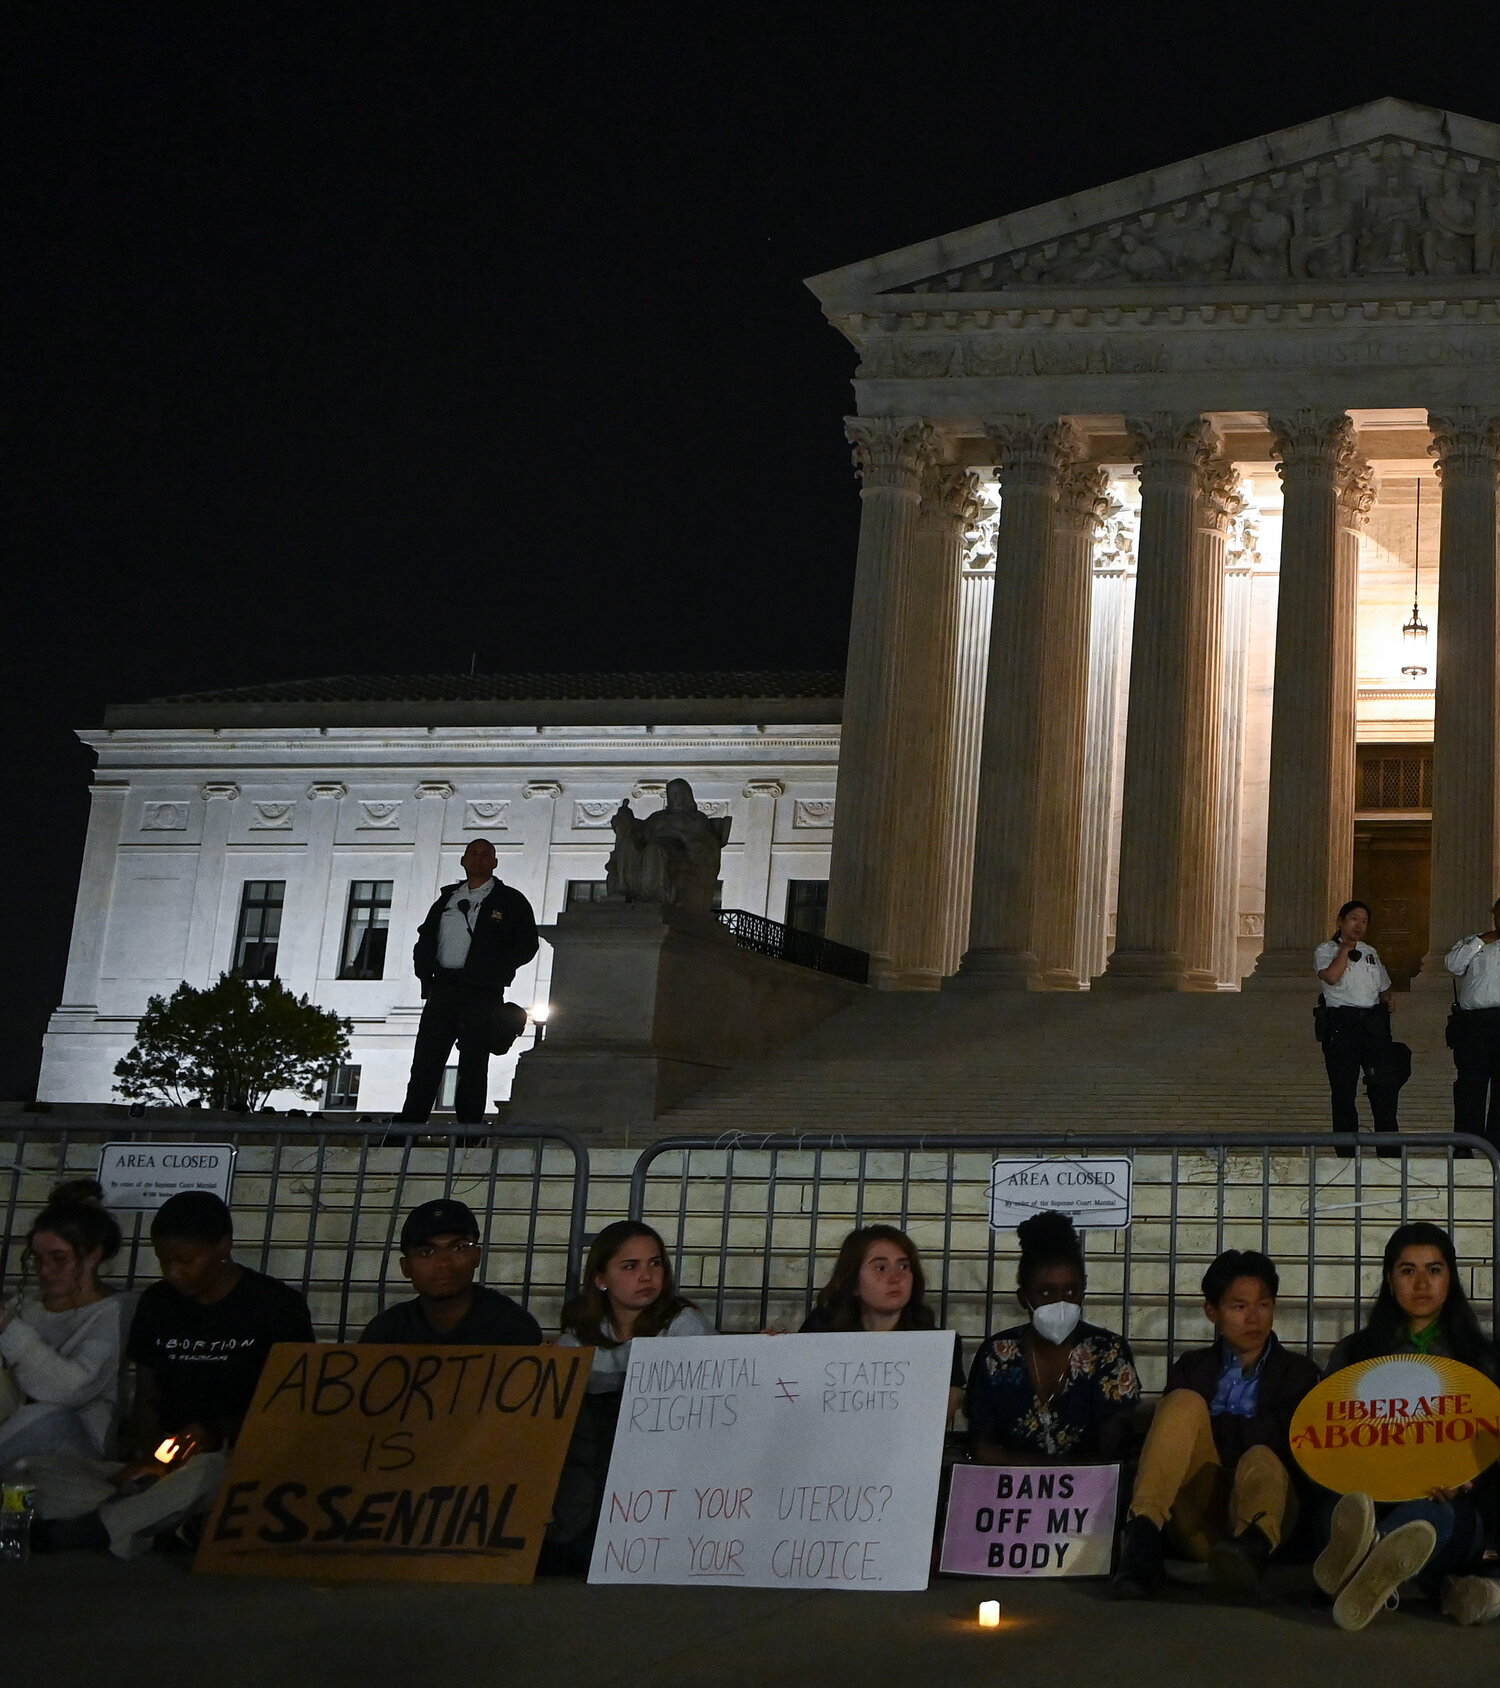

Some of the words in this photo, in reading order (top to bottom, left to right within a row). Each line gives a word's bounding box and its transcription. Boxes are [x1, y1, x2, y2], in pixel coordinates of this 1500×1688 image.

[116, 1154, 155, 1168] AREA
[162, 1155, 219, 1169] CLOSED
[1008, 1172, 1050, 1186] AREA
[1057, 1171, 1115, 1186] CLOSED
[263, 1350, 581, 1421] ABORTION
[628, 1358, 760, 1394] FUNDAMENTAL
[629, 1394, 738, 1432] RIGHTS
[823, 1389, 899, 1413] RIGHTS
[1326, 1394, 1472, 1421] LIBERATE
[1291, 1416, 1500, 1449] ABORTION
[363, 1432, 416, 1472] IS
[997, 1473, 1074, 1499] BANS
[214, 1480, 526, 1550] ESSENTIAL
[609, 1488, 677, 1523] NOT
[695, 1487, 753, 1520] YOUR
[778, 1484, 893, 1522] UTERUS?
[975, 1507, 1032, 1533] OFF
[1046, 1507, 1089, 1533] MY
[604, 1537, 669, 1573] NOT
[688, 1535, 745, 1572] YOUR
[987, 1542, 1070, 1568] BODY
